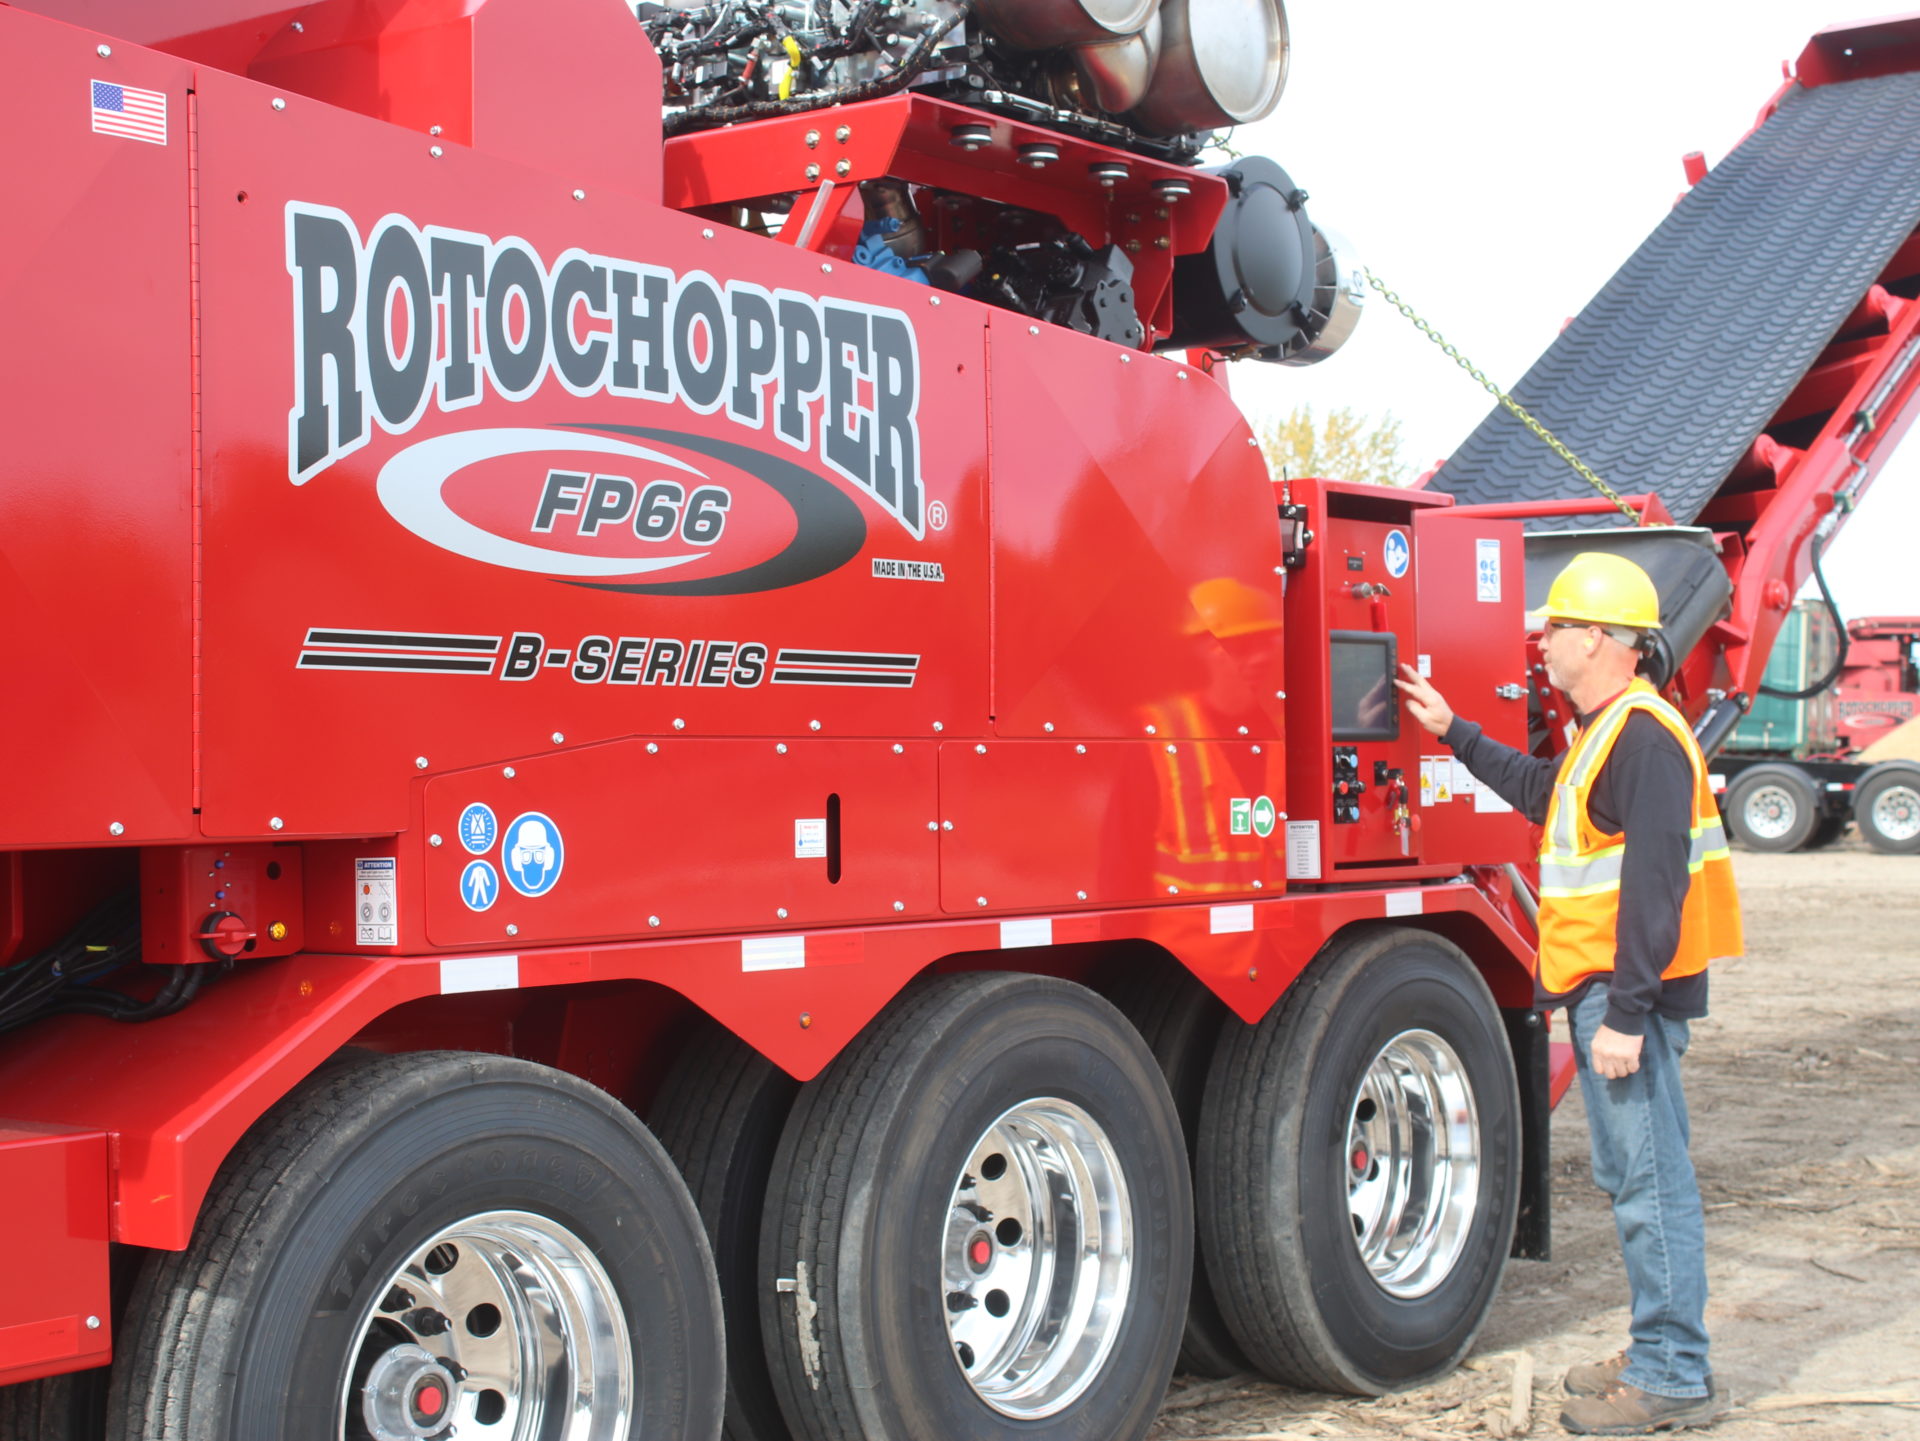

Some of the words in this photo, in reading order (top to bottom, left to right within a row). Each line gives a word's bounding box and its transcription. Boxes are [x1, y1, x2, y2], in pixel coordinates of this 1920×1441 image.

[285, 201, 925, 541] ROTOCHOPPER
[531, 468, 731, 546] FP66
[873, 560, 896, 576] MADE
[897, 562, 906, 577] IN
[907, 563, 922, 578] THE
[923, 564, 944, 580] U.S.A.
[499, 631, 768, 687] B-SERIES
[364, 861, 392, 869] ATTENTION
